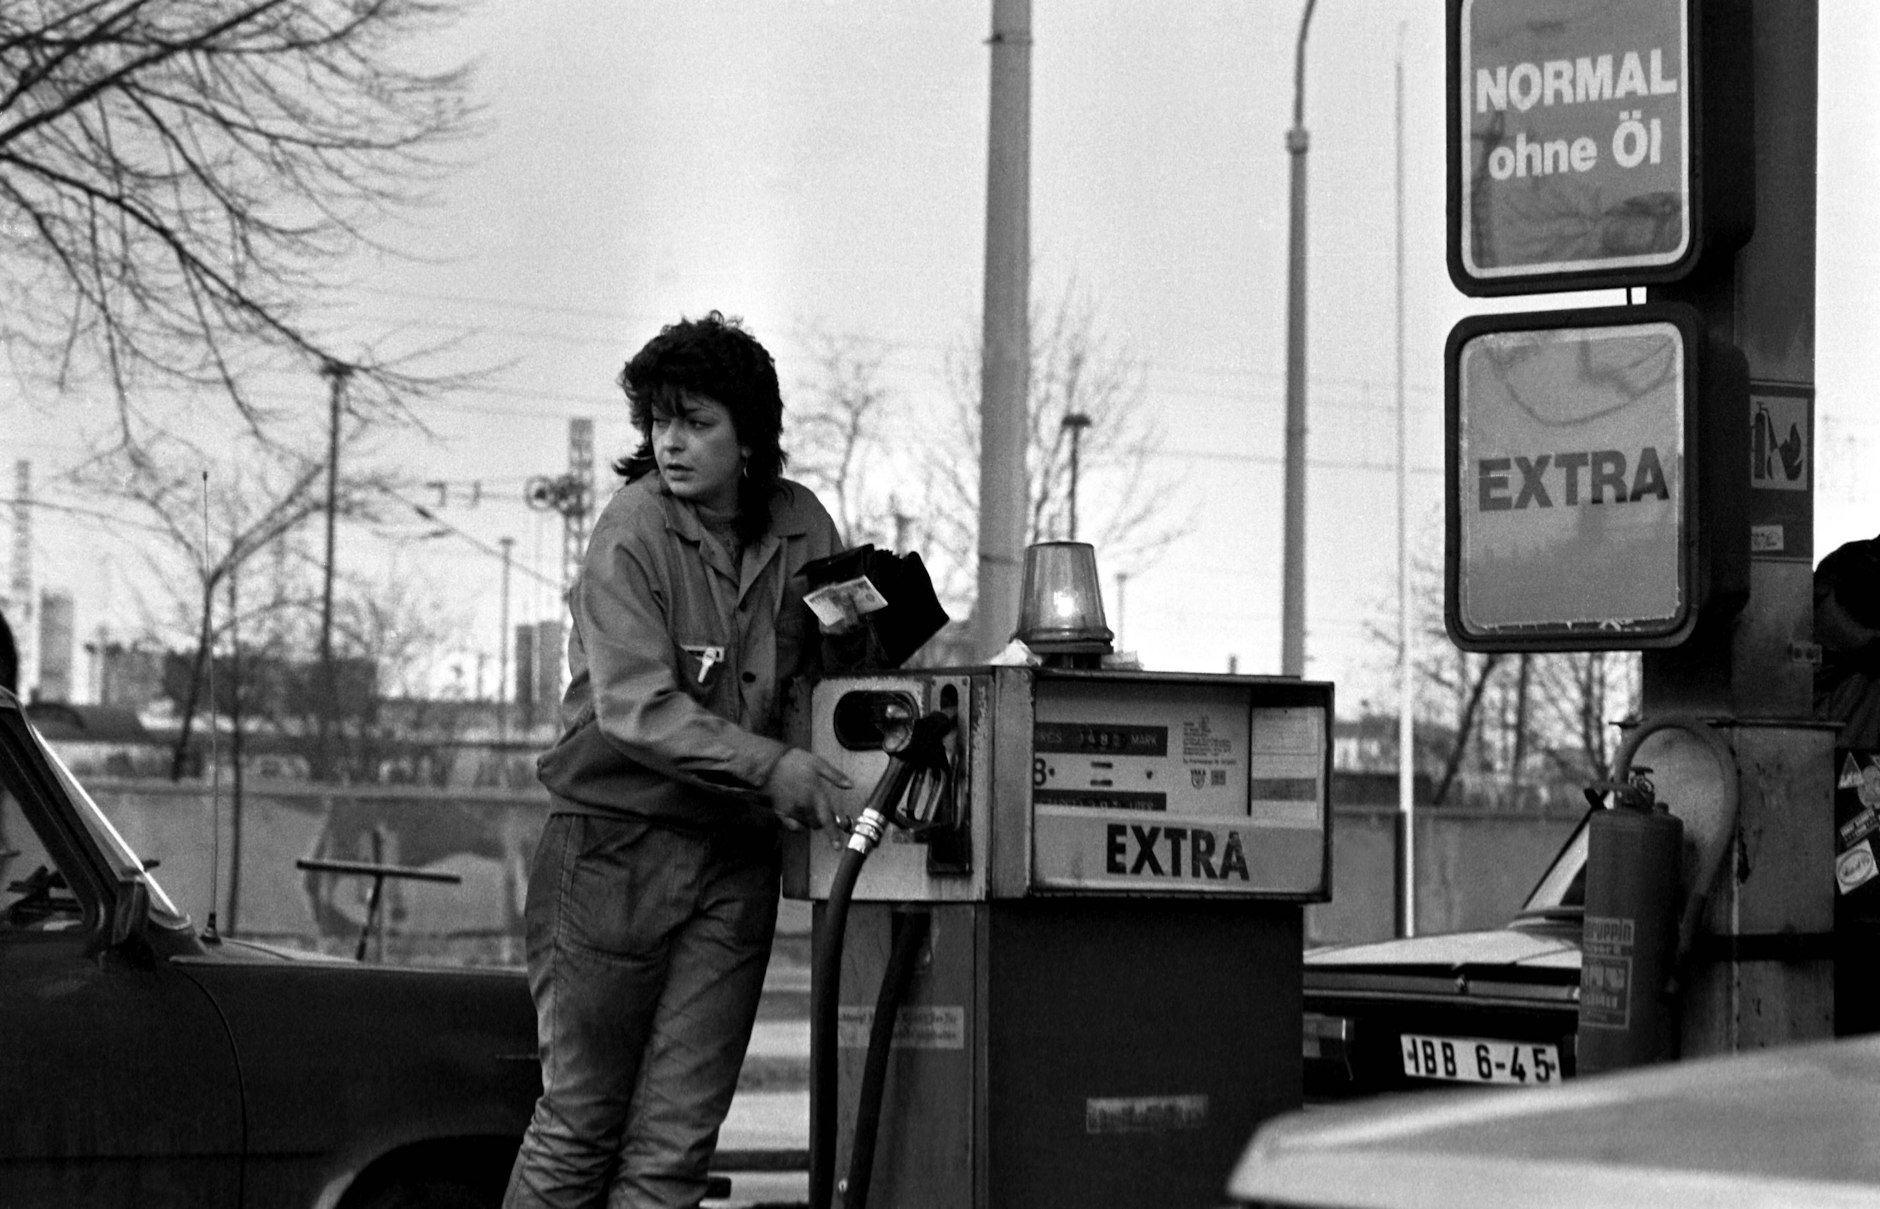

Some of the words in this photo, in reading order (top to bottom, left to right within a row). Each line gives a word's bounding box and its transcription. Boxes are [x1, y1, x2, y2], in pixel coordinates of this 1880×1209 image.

[1475, 48, 1678, 113] NORMAL
[1488, 133, 1598, 181] ohne
[1612, 110, 1662, 168] Öl
[1477, 447, 1671, 512] EXTRA
[1106, 823, 1251, 882] EXTRA
[1474, 1043, 1551, 1084] 6-45
